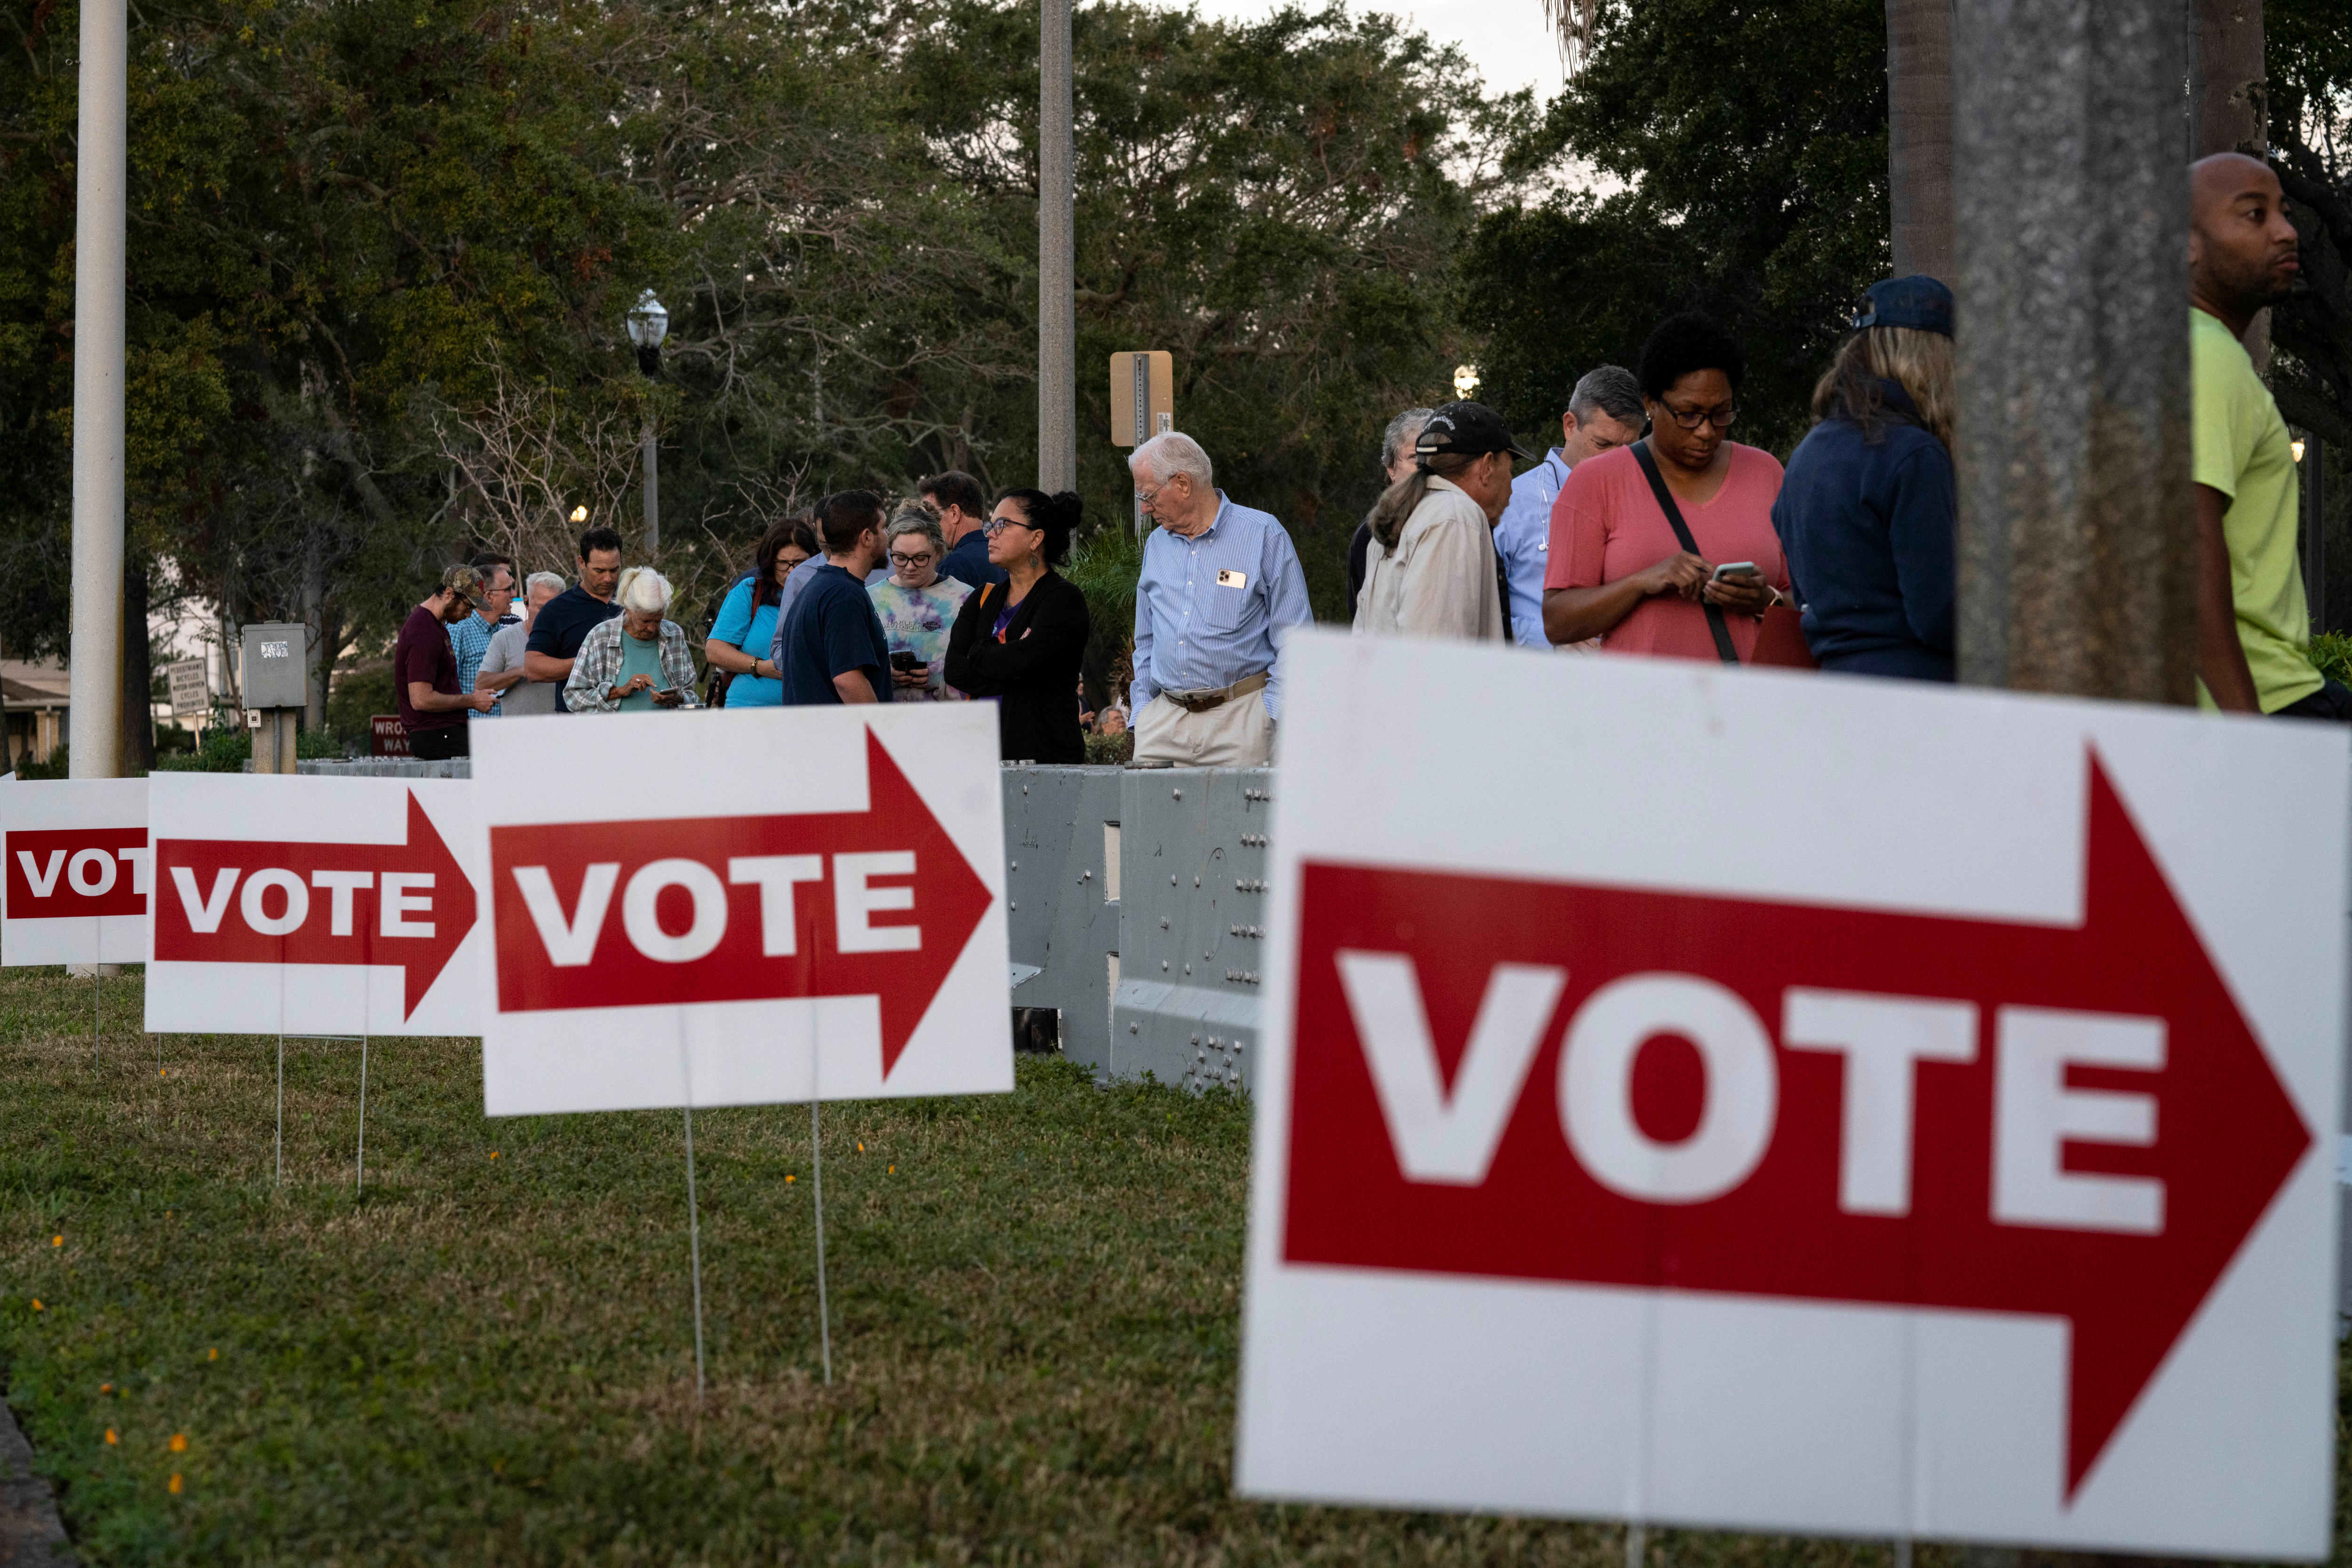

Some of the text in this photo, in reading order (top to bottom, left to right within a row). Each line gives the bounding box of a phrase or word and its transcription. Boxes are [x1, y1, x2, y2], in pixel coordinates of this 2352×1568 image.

[375, 721, 406, 735] WRO
[384, 739, 410, 752] WAY
[16, 848, 148, 897] VOT
[170, 867, 435, 938] VOTE
[512, 851, 921, 966] VOTE
[1339, 953, 2165, 1233] VOTE
